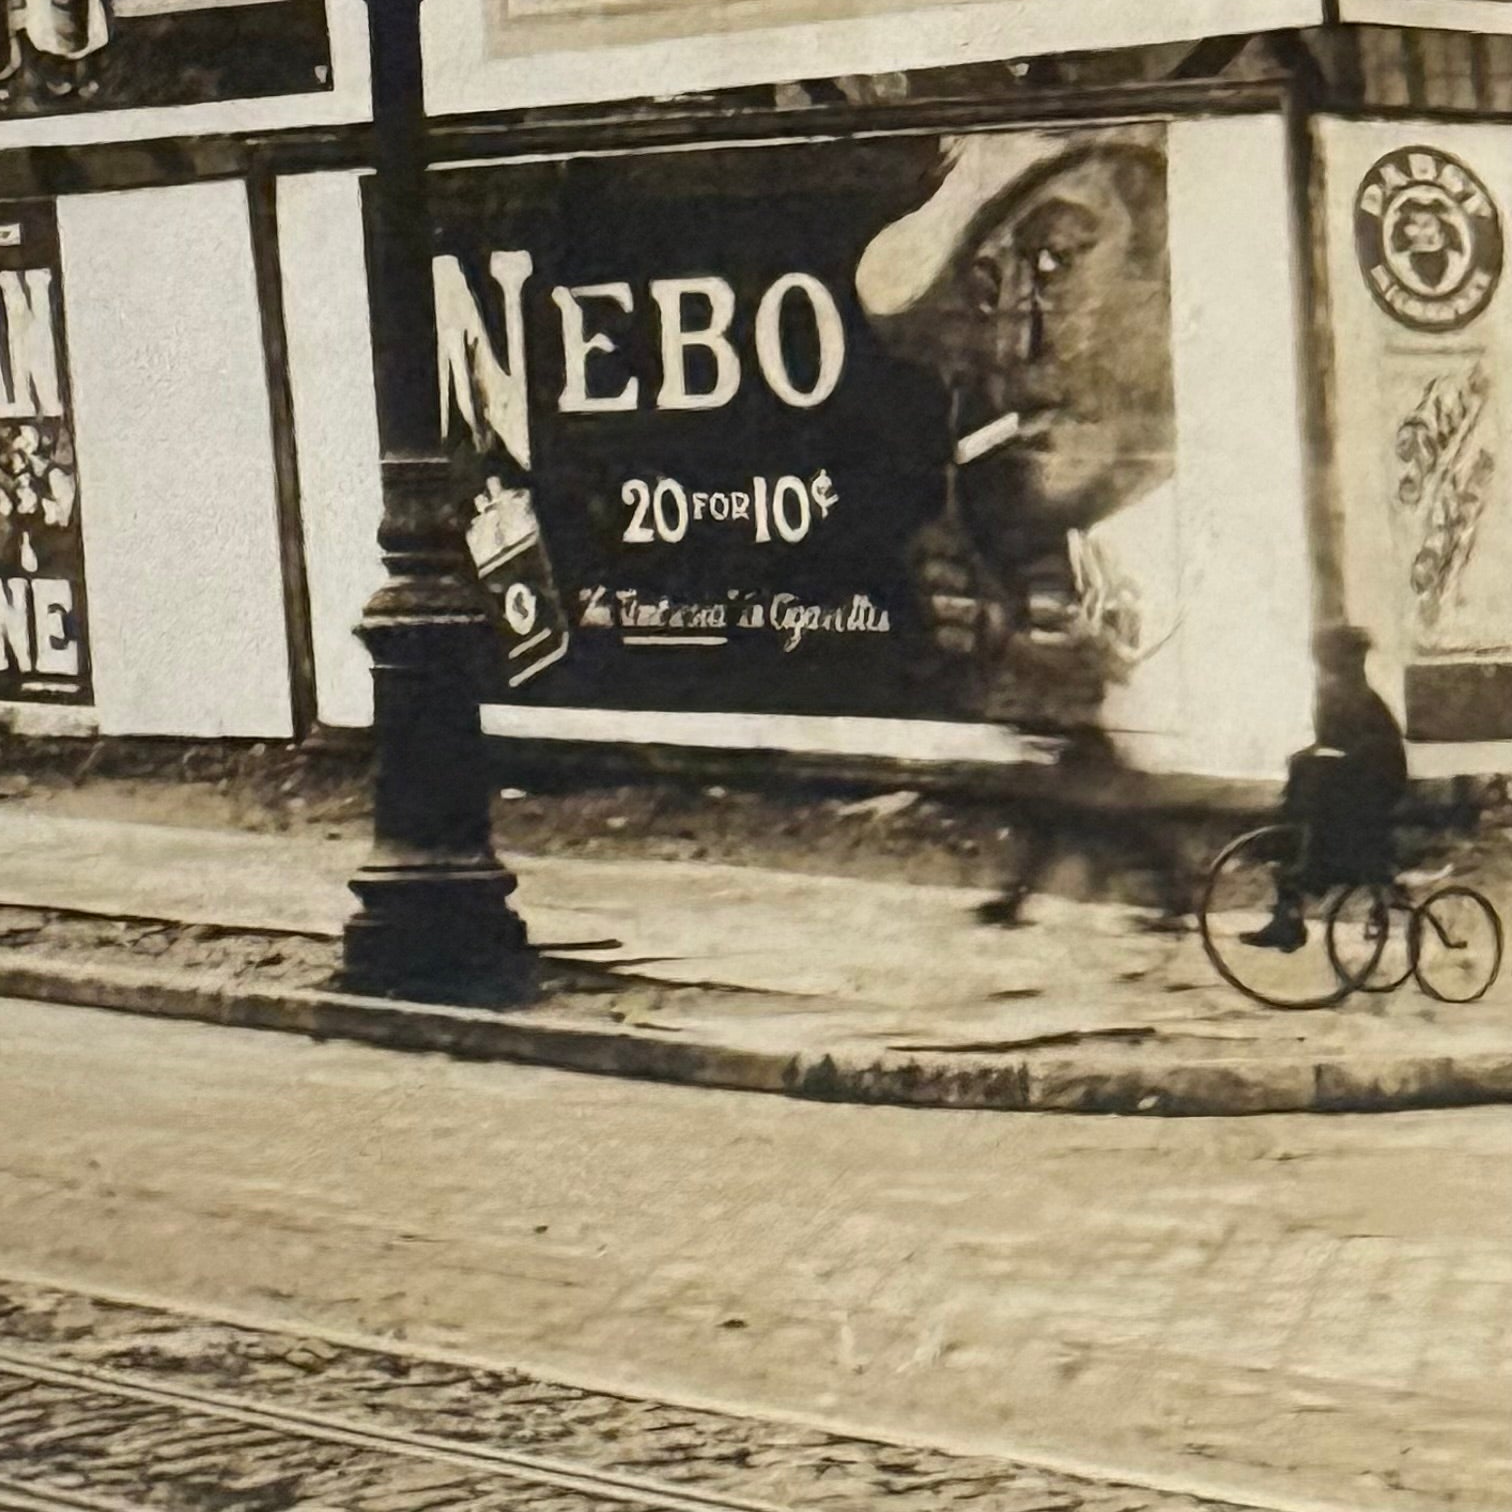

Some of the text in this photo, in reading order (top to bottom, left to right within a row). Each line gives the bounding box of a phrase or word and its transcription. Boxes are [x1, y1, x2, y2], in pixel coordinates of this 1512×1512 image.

[432, 249, 847, 471] NEBO
[620, 478, 689, 544] 20
[693, 491, 751, 521] FOR
